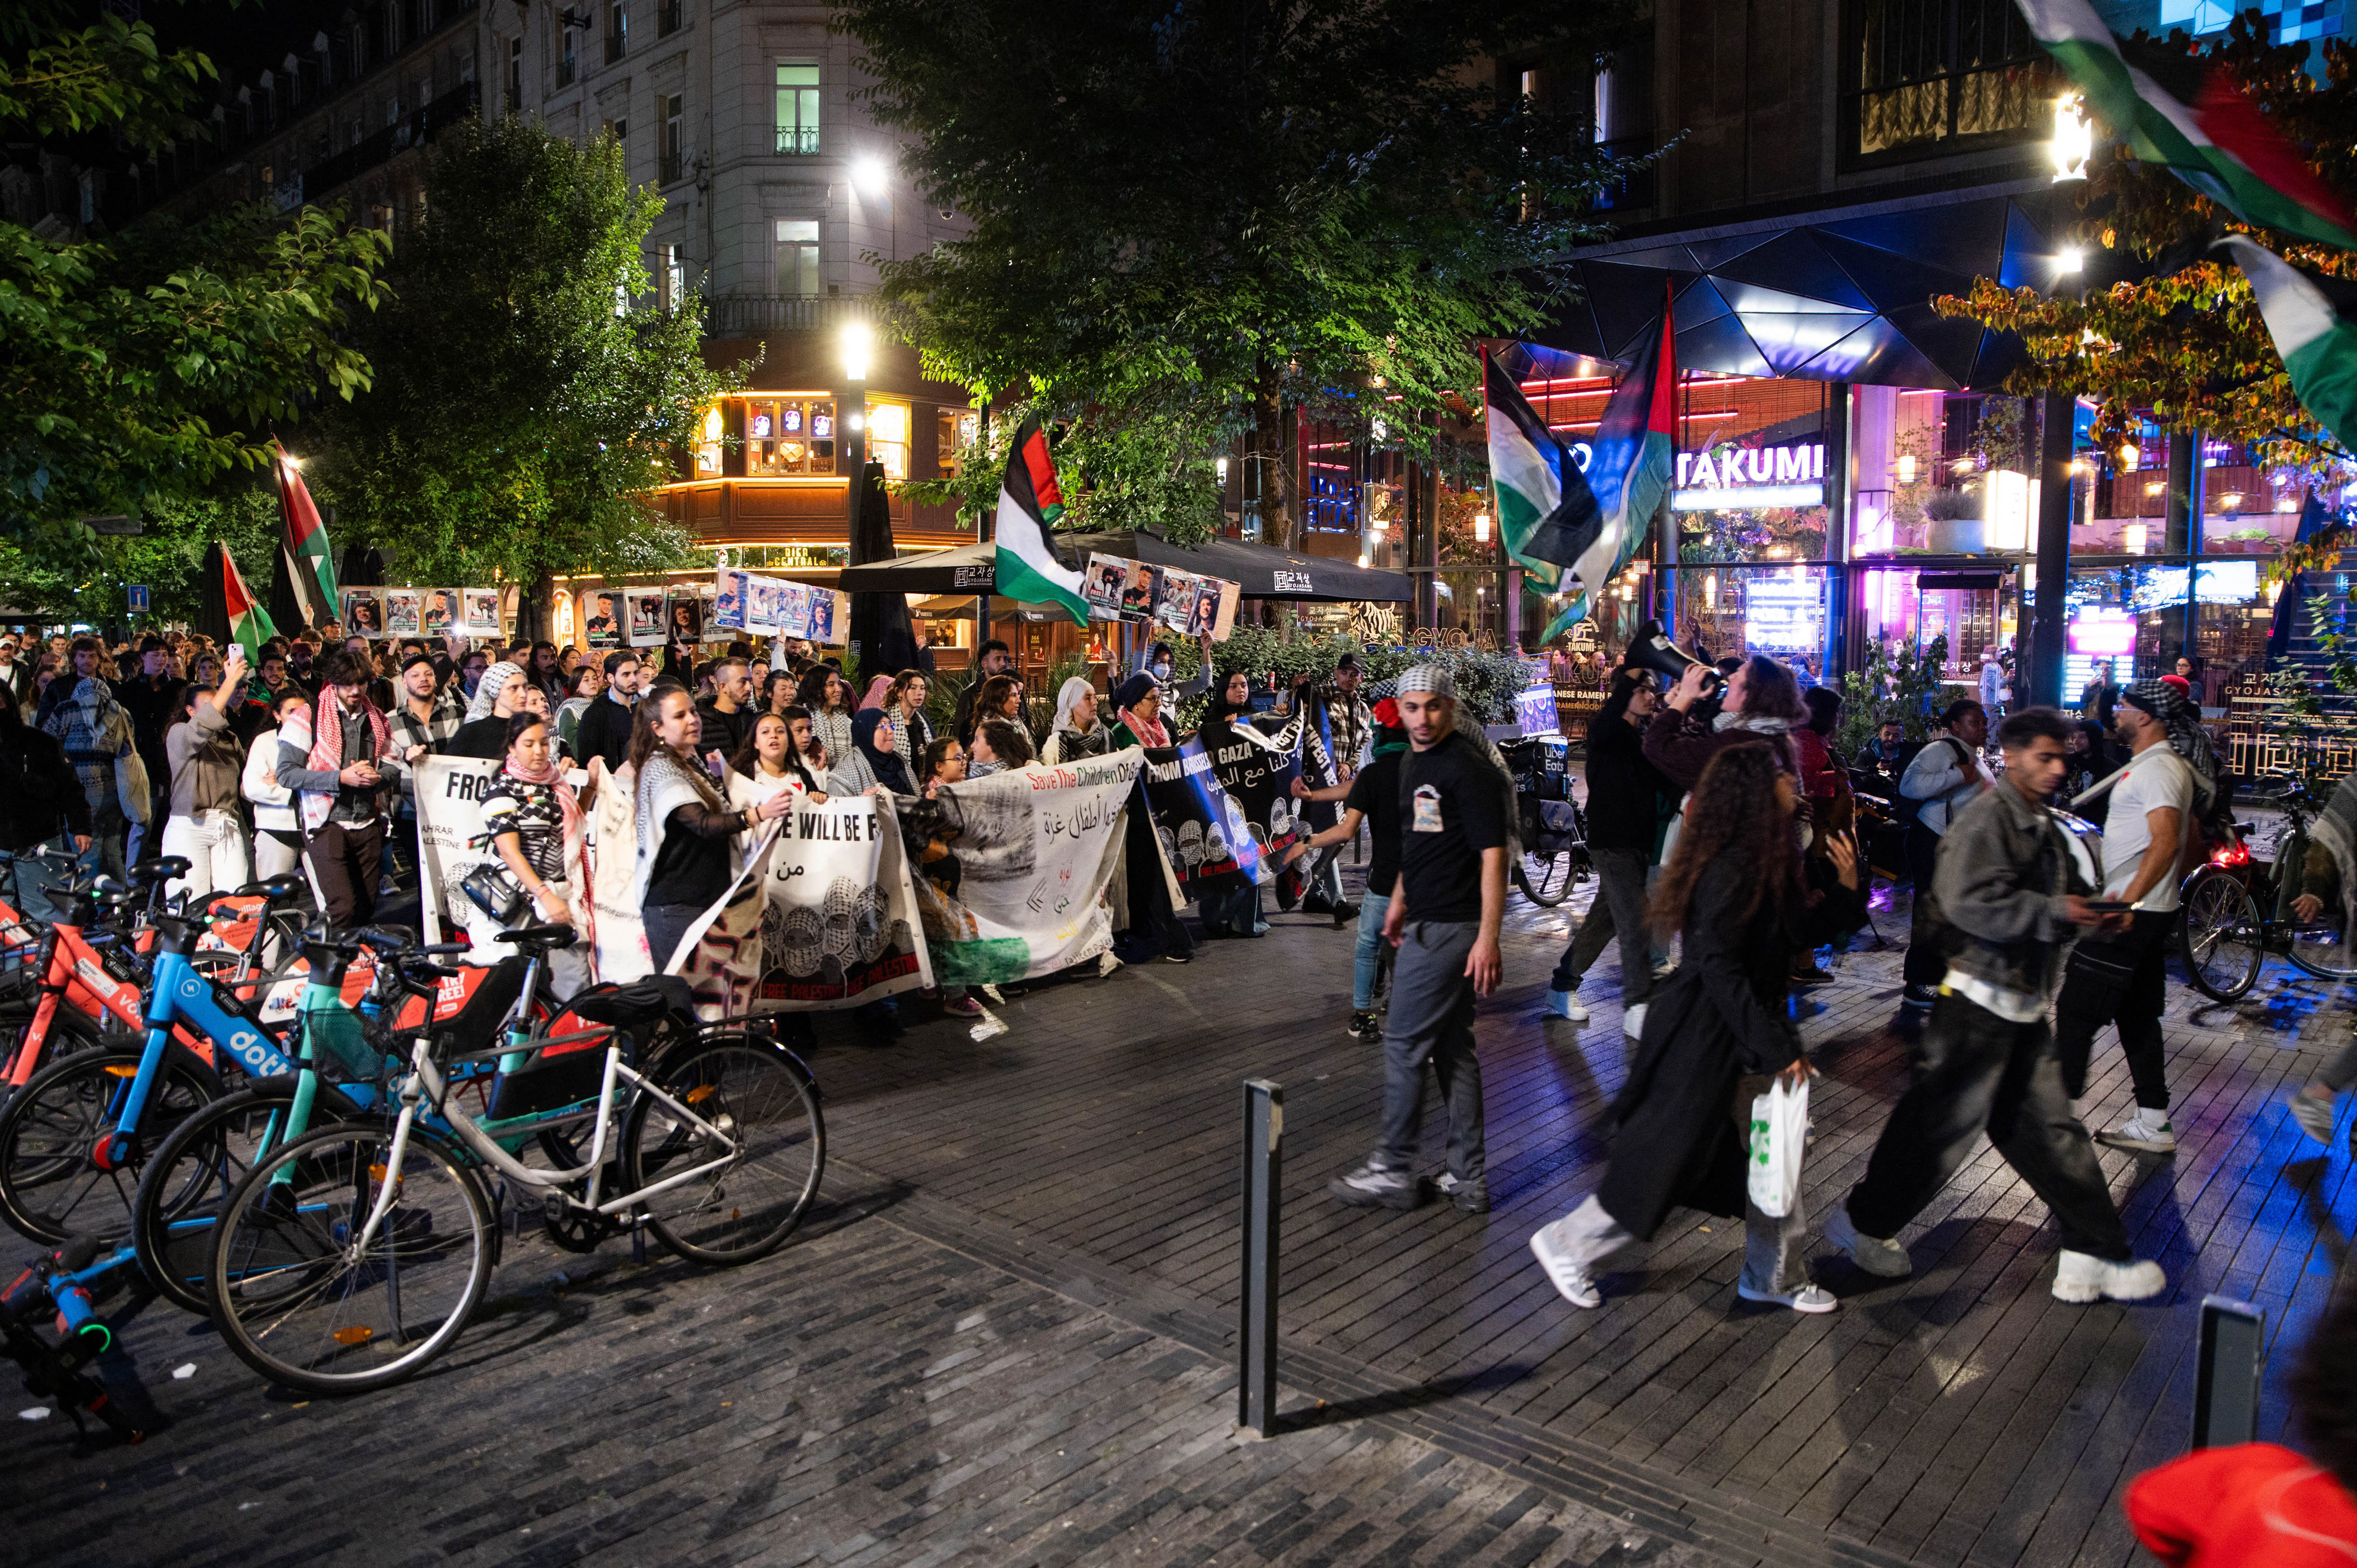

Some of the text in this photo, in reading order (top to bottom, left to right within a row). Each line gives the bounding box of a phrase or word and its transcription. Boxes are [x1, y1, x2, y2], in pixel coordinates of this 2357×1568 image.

[1677, 444, 1824, 485] TAKUMI
[785, 548, 808, 557] BIER
[775, 557, 819, 566] CENTRAL
[968, 566, 995, 578] 교자상
[1287, 572, 1310, 584] 교자상
[1309, 606, 1332, 615] 교자상
[1939, 662, 1972, 673] 교자상
[2243, 673, 2293, 686] 교자
[1552, 690, 1576, 698] ANESE
[1577, 691, 1605, 700] RAMEN
[2225, 687, 2311, 696] GYOJAS
[1544, 747, 1566, 759] Uber
[1147, 760, 1182, 783] FROM
[1183, 752, 1213, 777] BRUSSELS
[1218, 741, 1253, 765] GAZA
[1545, 759, 1564, 772] Eats
[1026, 773, 1057, 790] Save
[1055, 768, 1076, 788] The
[1077, 766, 1118, 787] Children
[1118, 763, 1129, 783] Of
[446, 772, 490, 801] FRO
[422, 824, 453, 836] AHRAR
[800, 813, 841, 841] WILL
[844, 815, 861, 842] BE
[423, 838, 460, 849] ALESTINE
[776, 861, 804, 881] من
[868, 953, 920, 987] PALESTIN
[441, 971, 465, 987] TRY
[437, 984, 465, 1002] REE!
[229, 1031, 289, 1077] dott
